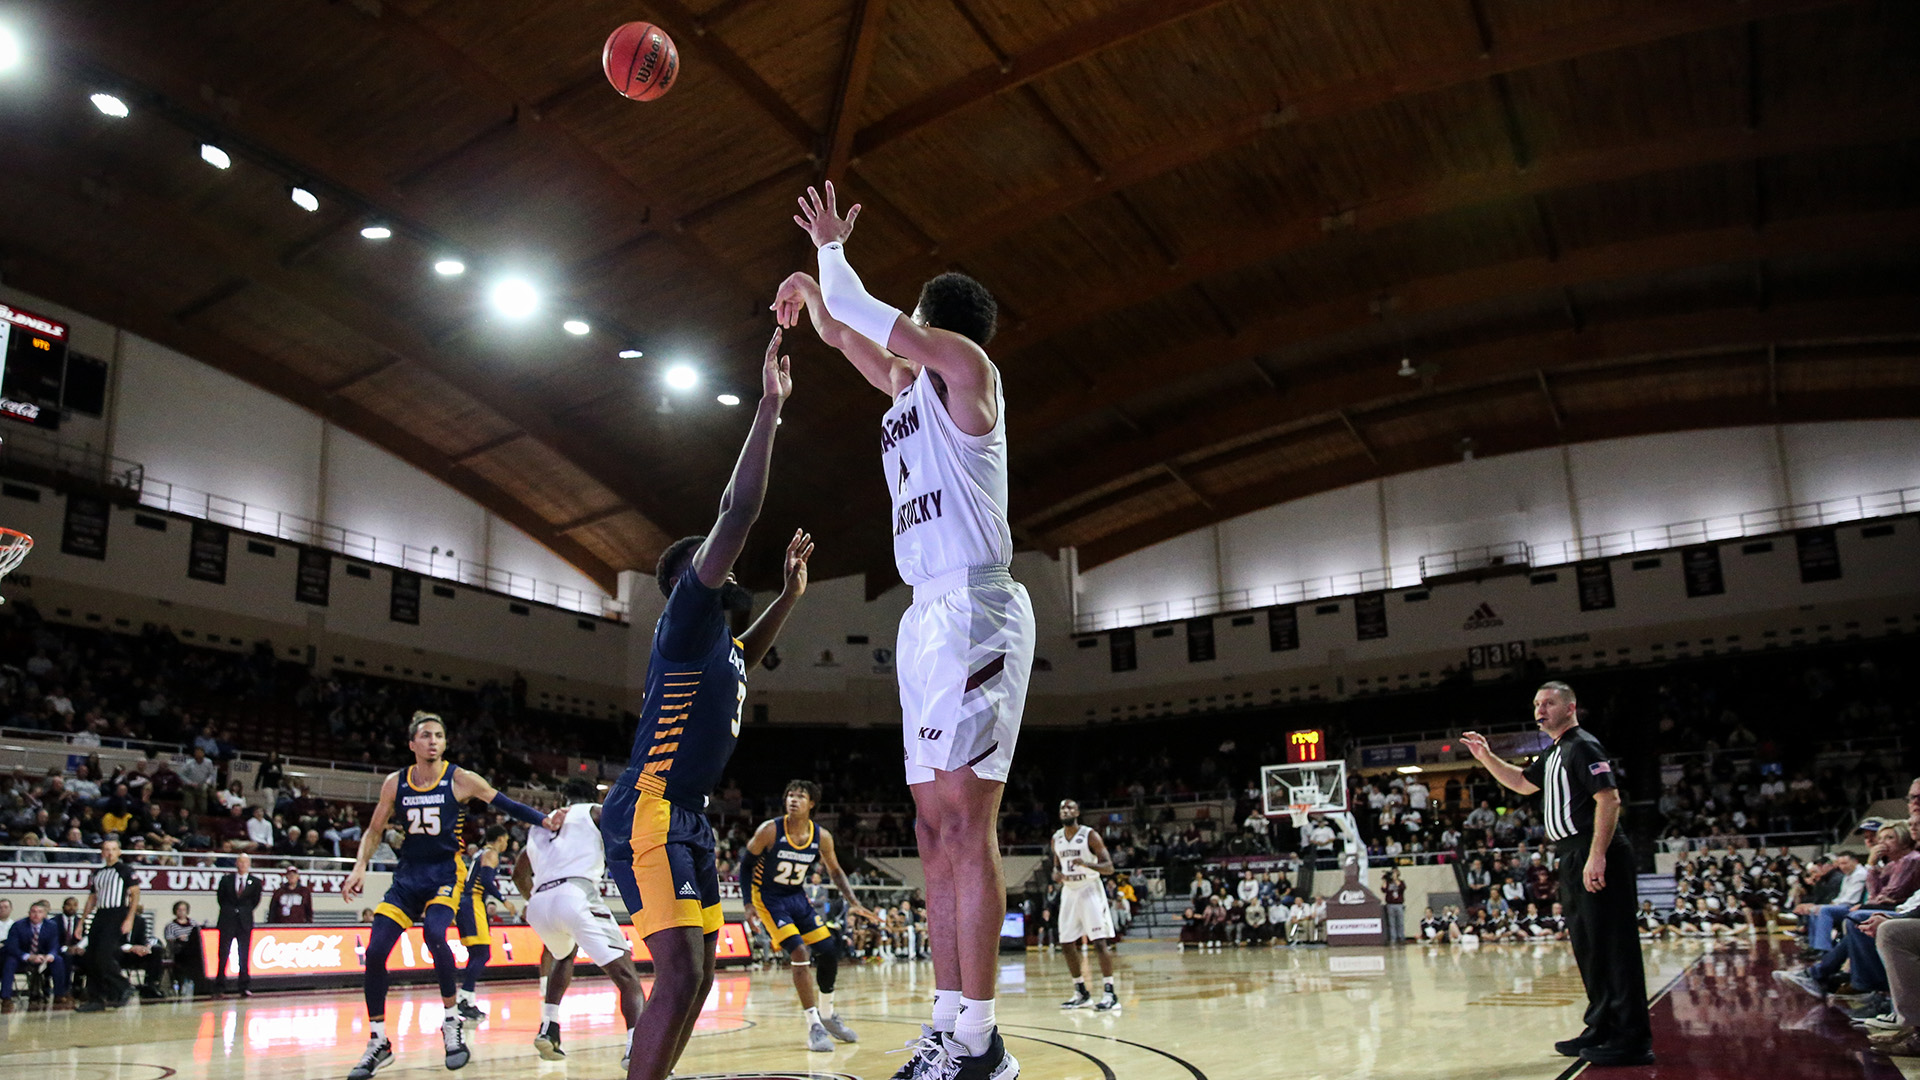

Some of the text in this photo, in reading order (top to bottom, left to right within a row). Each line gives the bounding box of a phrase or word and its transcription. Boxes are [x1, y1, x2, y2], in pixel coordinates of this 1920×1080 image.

[635, 34, 663, 84] Wilson
[32, 338, 50, 351] UTC
[1300, 744, 1316, 761] 11
[407, 806, 442, 836] 25
[0, 867, 345, 893] ENTUY UNIRITY
[773, 861, 809, 885] 23
[252, 934, 343, 969] Coca-Cola
